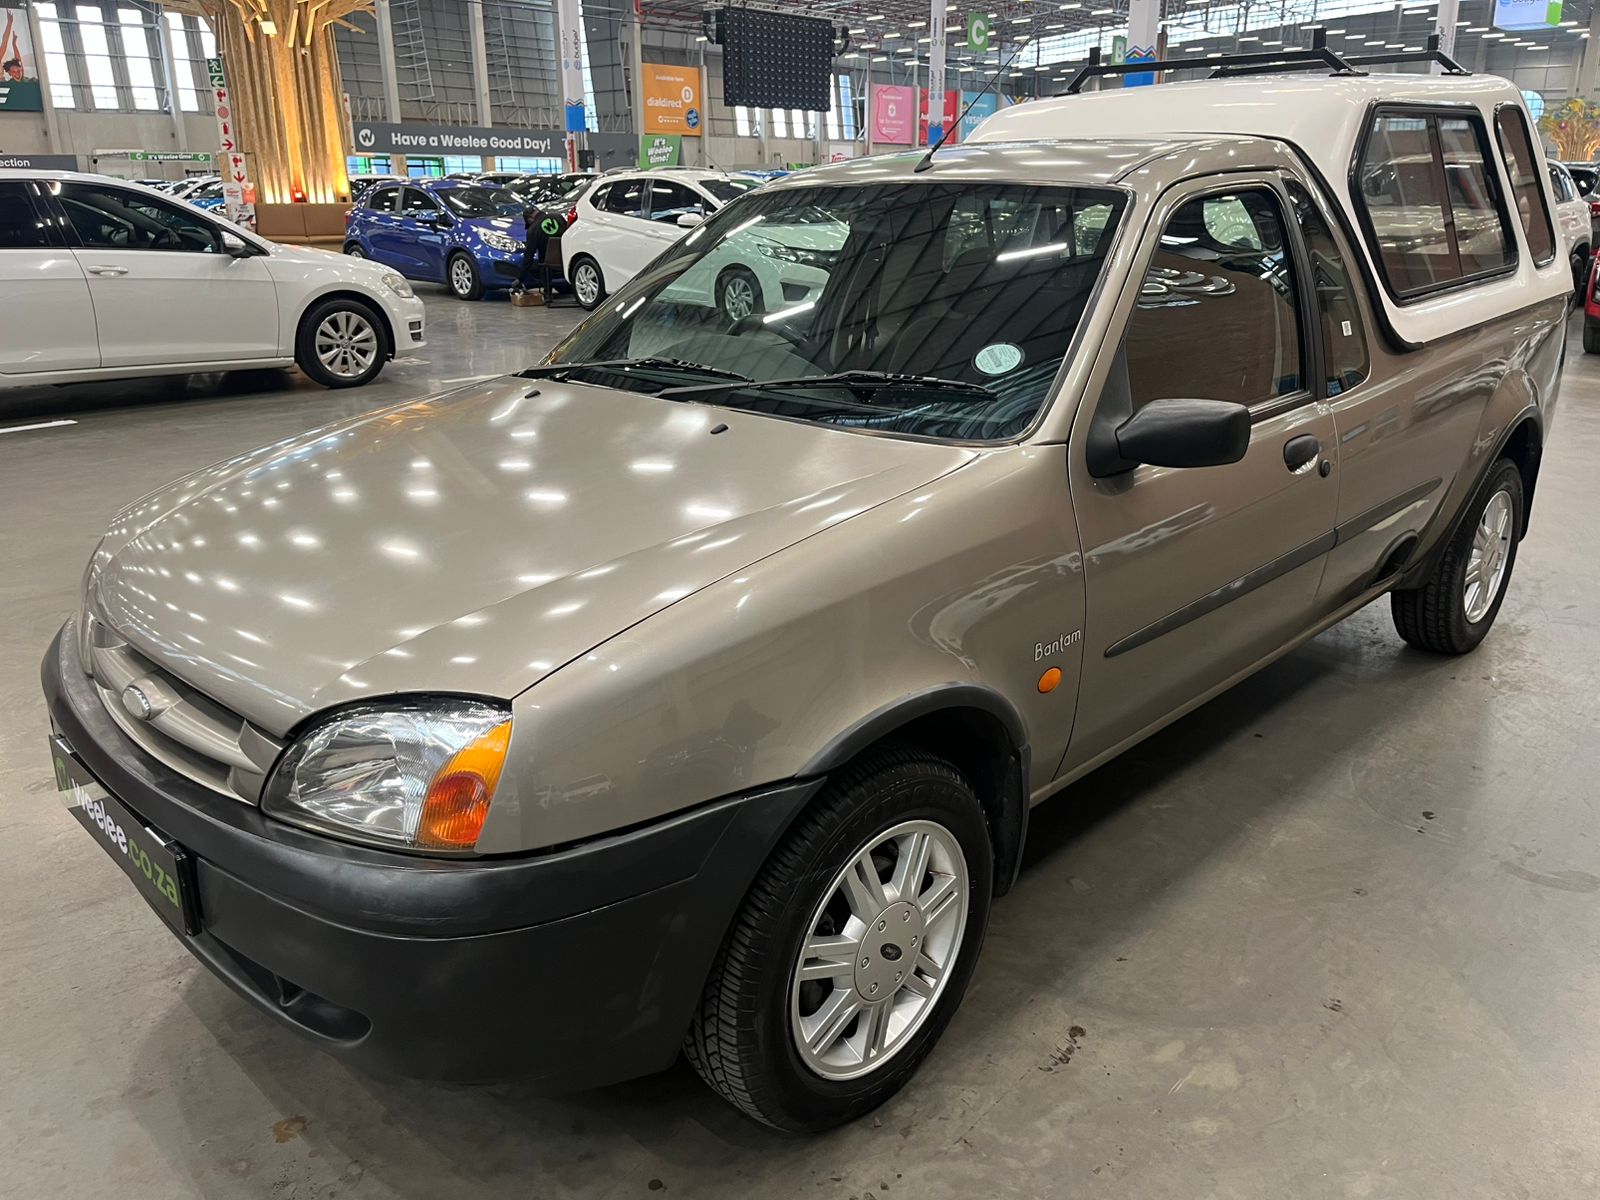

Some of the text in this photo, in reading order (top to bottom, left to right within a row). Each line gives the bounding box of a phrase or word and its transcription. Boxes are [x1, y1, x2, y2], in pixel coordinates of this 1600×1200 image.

[972, 20, 985, 45] C
[391, 132, 551, 153] Have a Weelee Good Day!
[1034, 629, 1081, 662] Bantam
